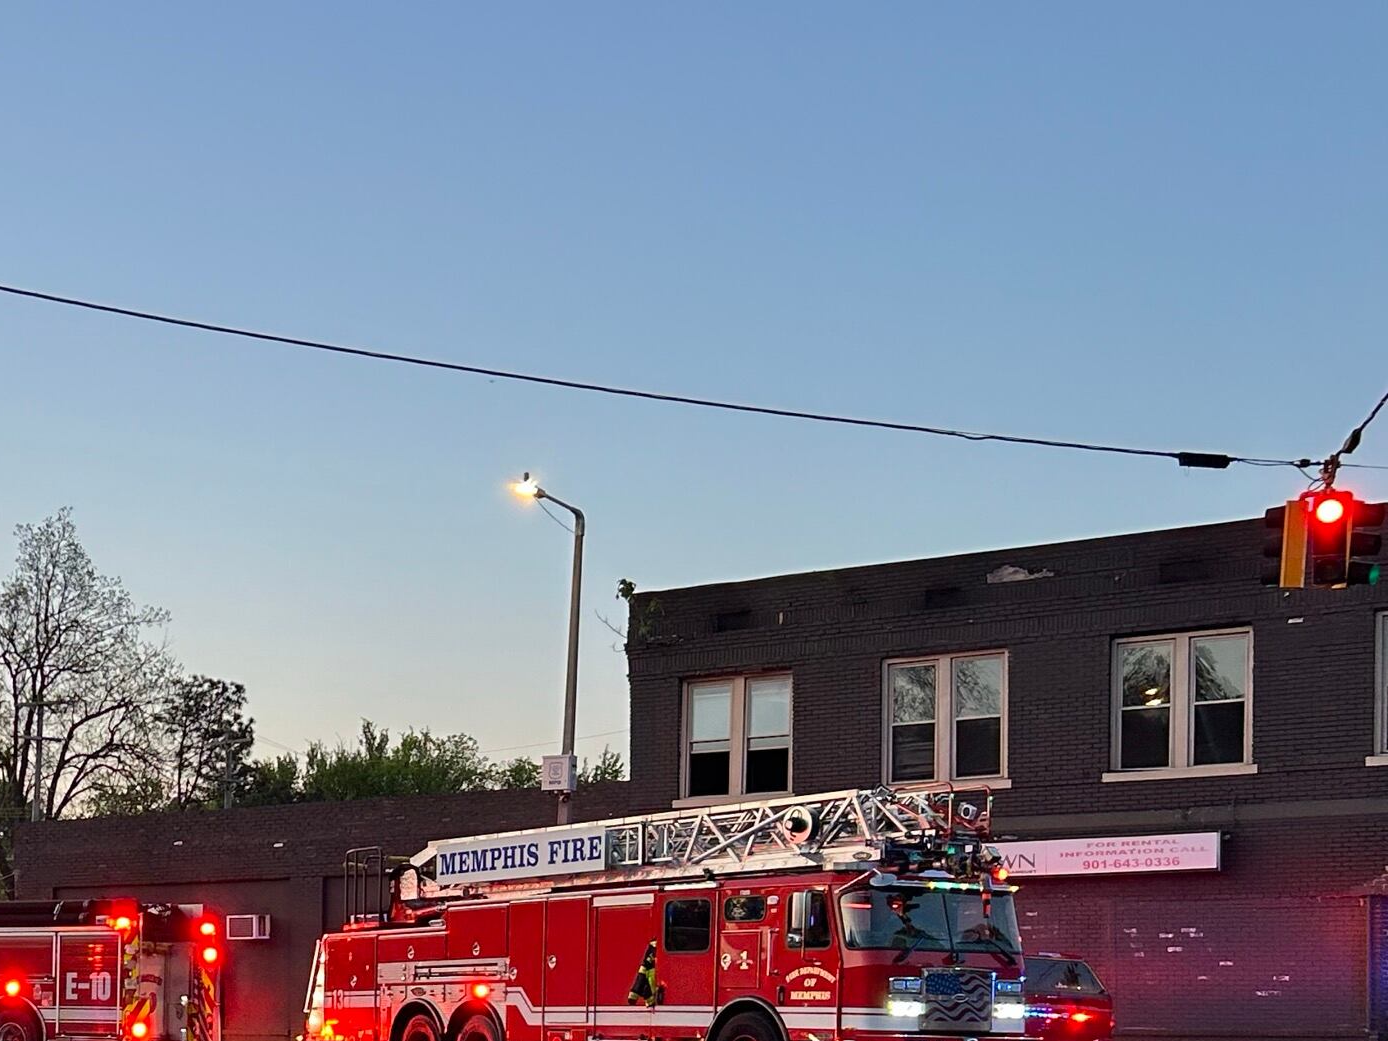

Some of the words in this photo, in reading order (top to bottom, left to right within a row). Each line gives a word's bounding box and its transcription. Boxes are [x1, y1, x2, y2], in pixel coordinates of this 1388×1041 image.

[1121, 838, 1181, 847] RENTAL
[439, 842, 539, 876] MEMPHIS
[548, 836, 602, 865] FIRE
[1059, 847, 1164, 857] INFORMATION
[1001, 853, 1036, 869] WN
[1083, 856, 1181, 870] 901-643-0336
[65, 971, 111, 1001] E-10
